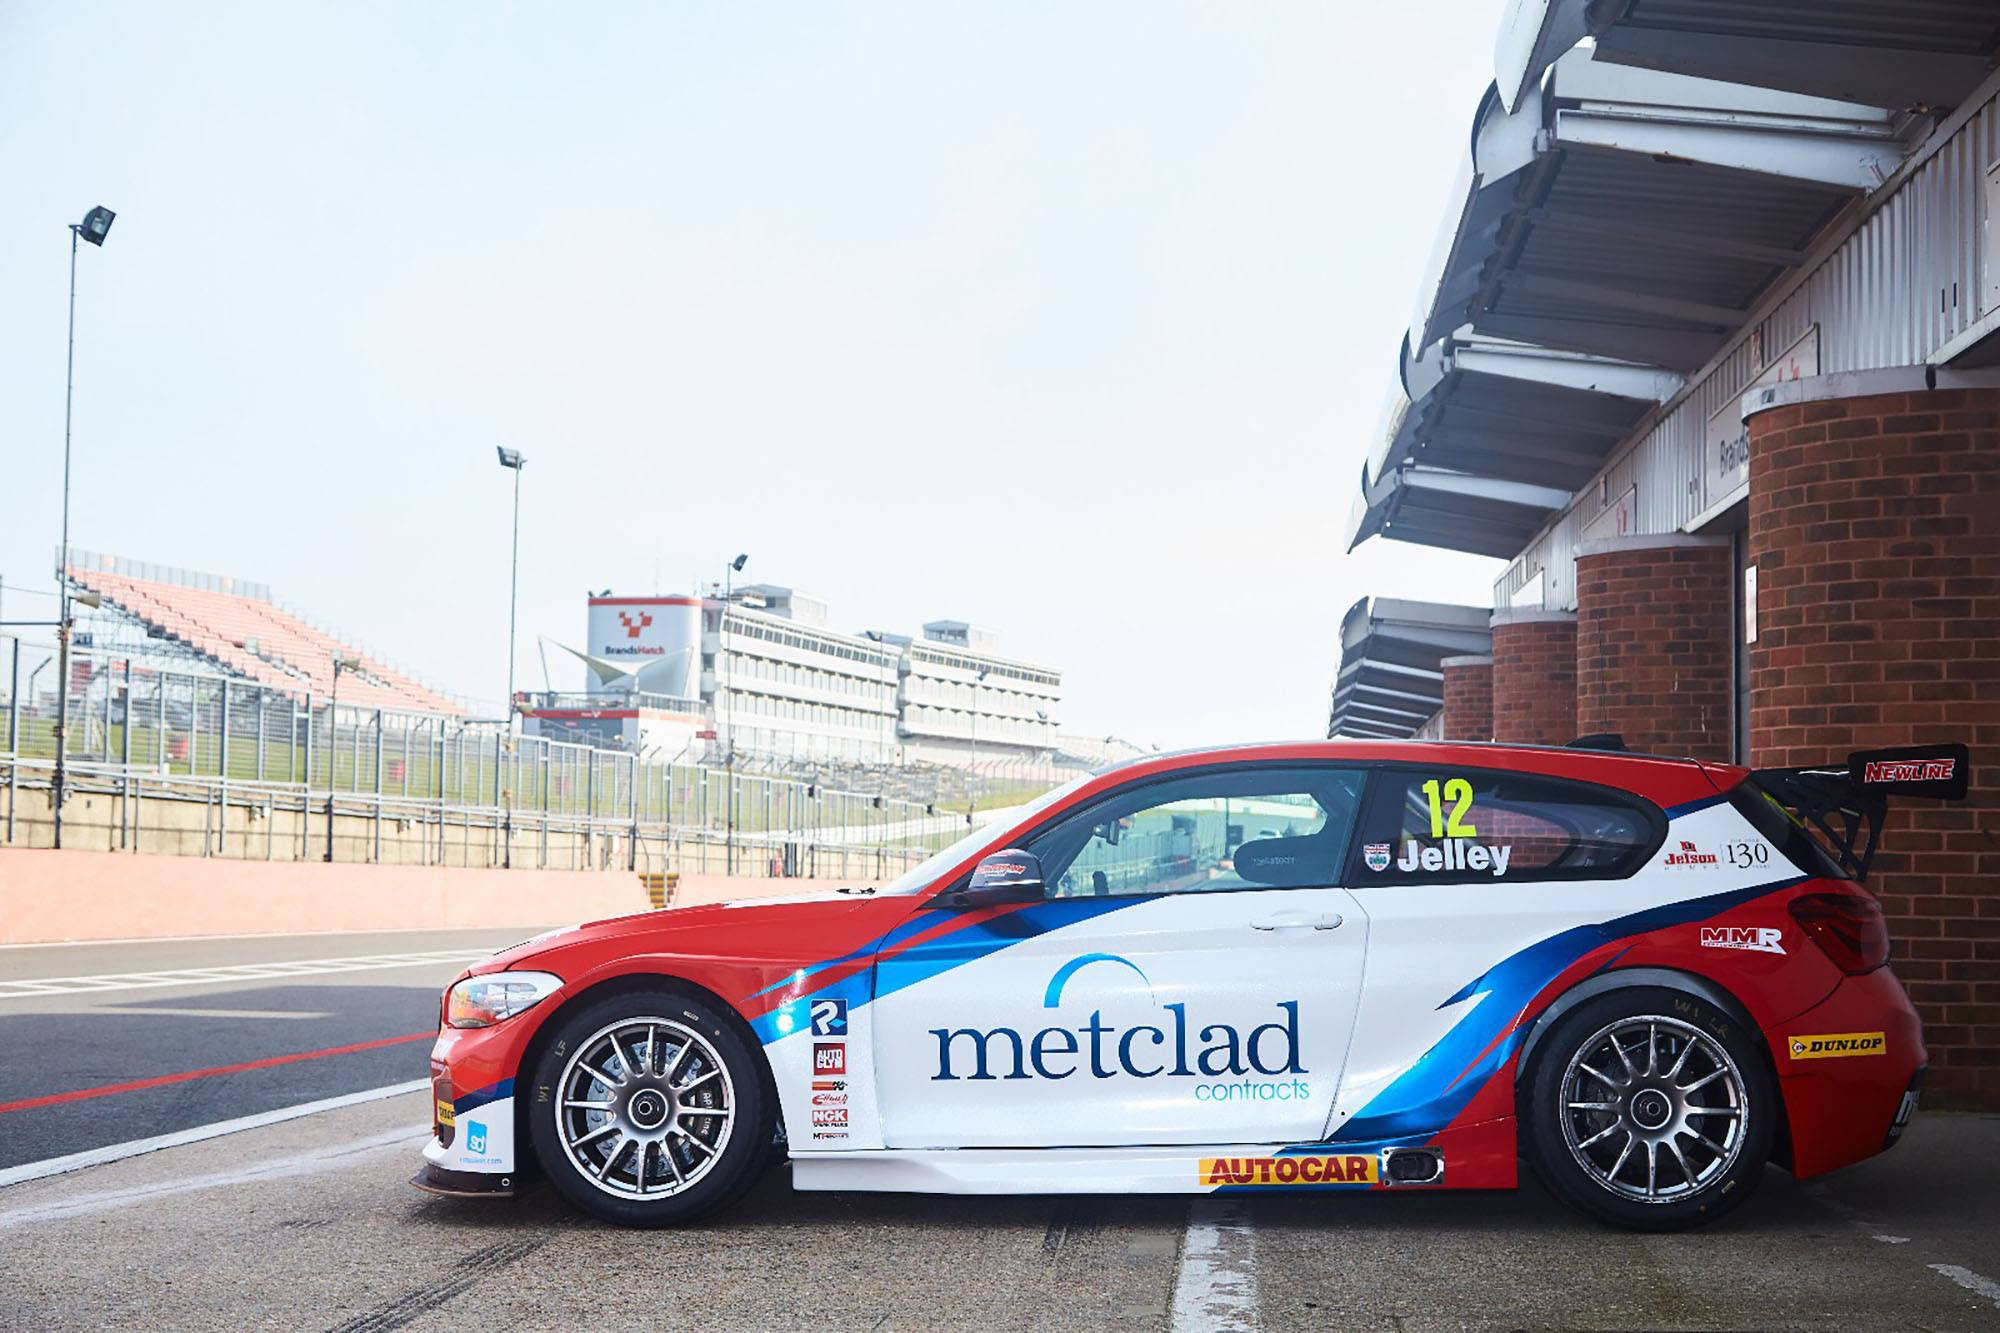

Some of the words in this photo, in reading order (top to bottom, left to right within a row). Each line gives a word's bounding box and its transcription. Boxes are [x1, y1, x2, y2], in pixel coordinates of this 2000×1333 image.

[1422, 779, 1477, 838] 12
[1397, 839, 1511, 876] Jelley
[1664, 853, 1717, 865] Jelson
[1727, 843, 1768, 868] 130
[1701, 928, 1787, 953] MMR
[929, 1000, 1309, 1081] metclad
[1810, 1039, 1882, 1052] DUNLOP
[817, 1049, 843, 1059] AUTO
[1195, 1079, 1309, 1101] contracts
[813, 1110, 847, 1122] NGK
[1208, 1157, 1369, 1183] AUTOCAR
